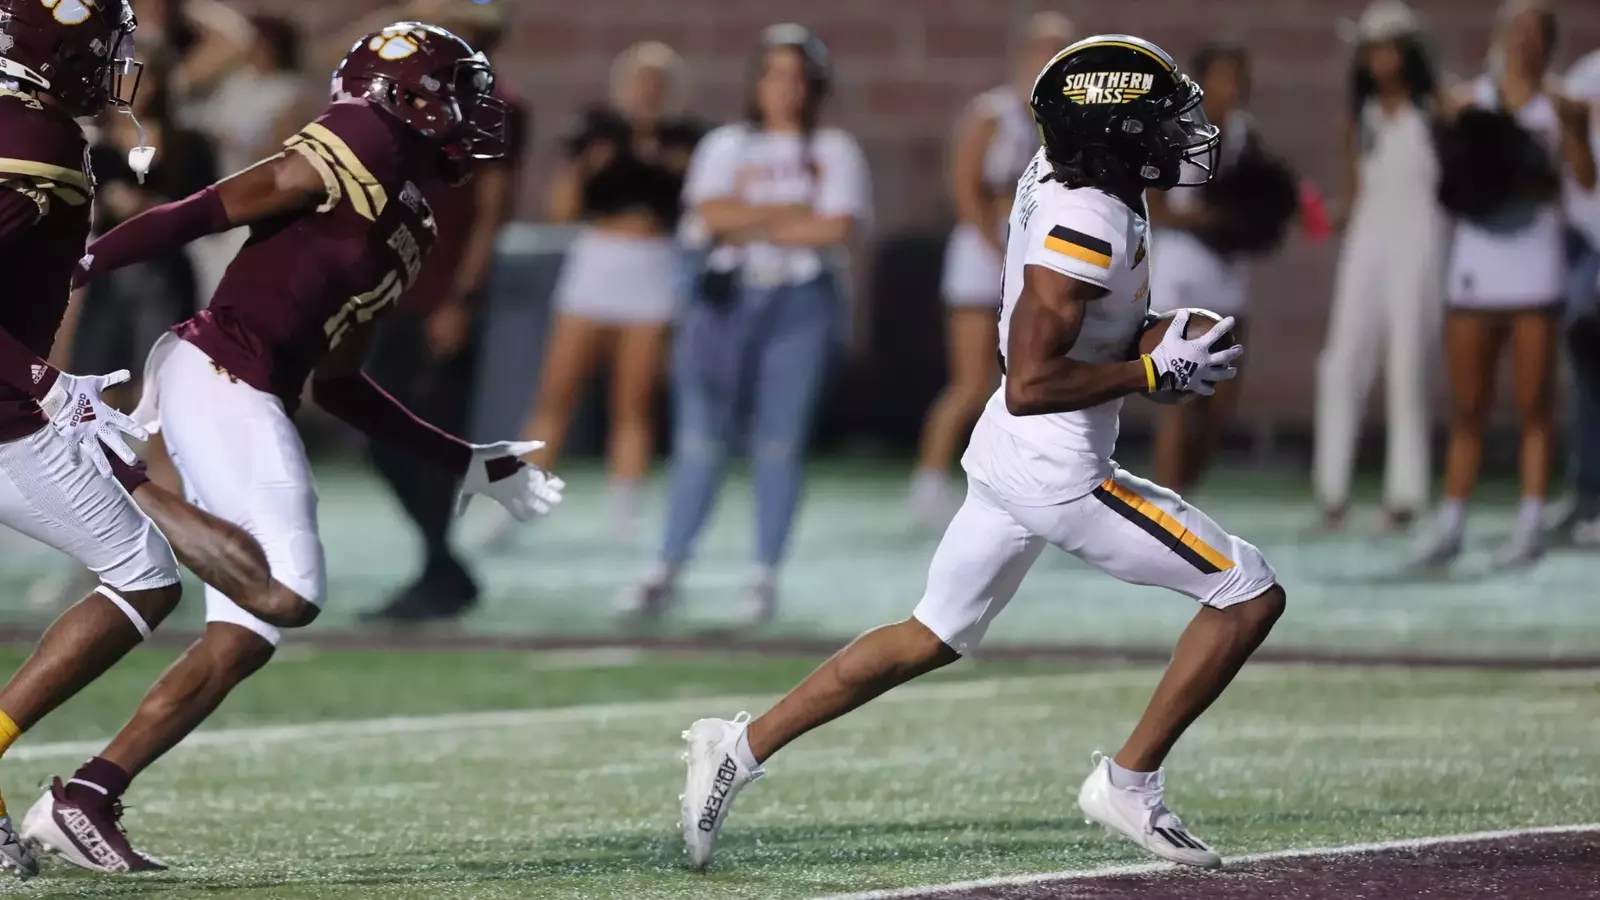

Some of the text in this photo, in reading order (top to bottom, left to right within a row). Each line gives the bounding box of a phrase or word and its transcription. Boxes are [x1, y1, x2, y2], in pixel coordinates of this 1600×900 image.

[1063, 71, 1154, 91] SOUTHERN
[1085, 87, 1124, 104] MISS
[70, 393, 87, 427] adidas
[698, 753, 738, 832] ADIZERO
